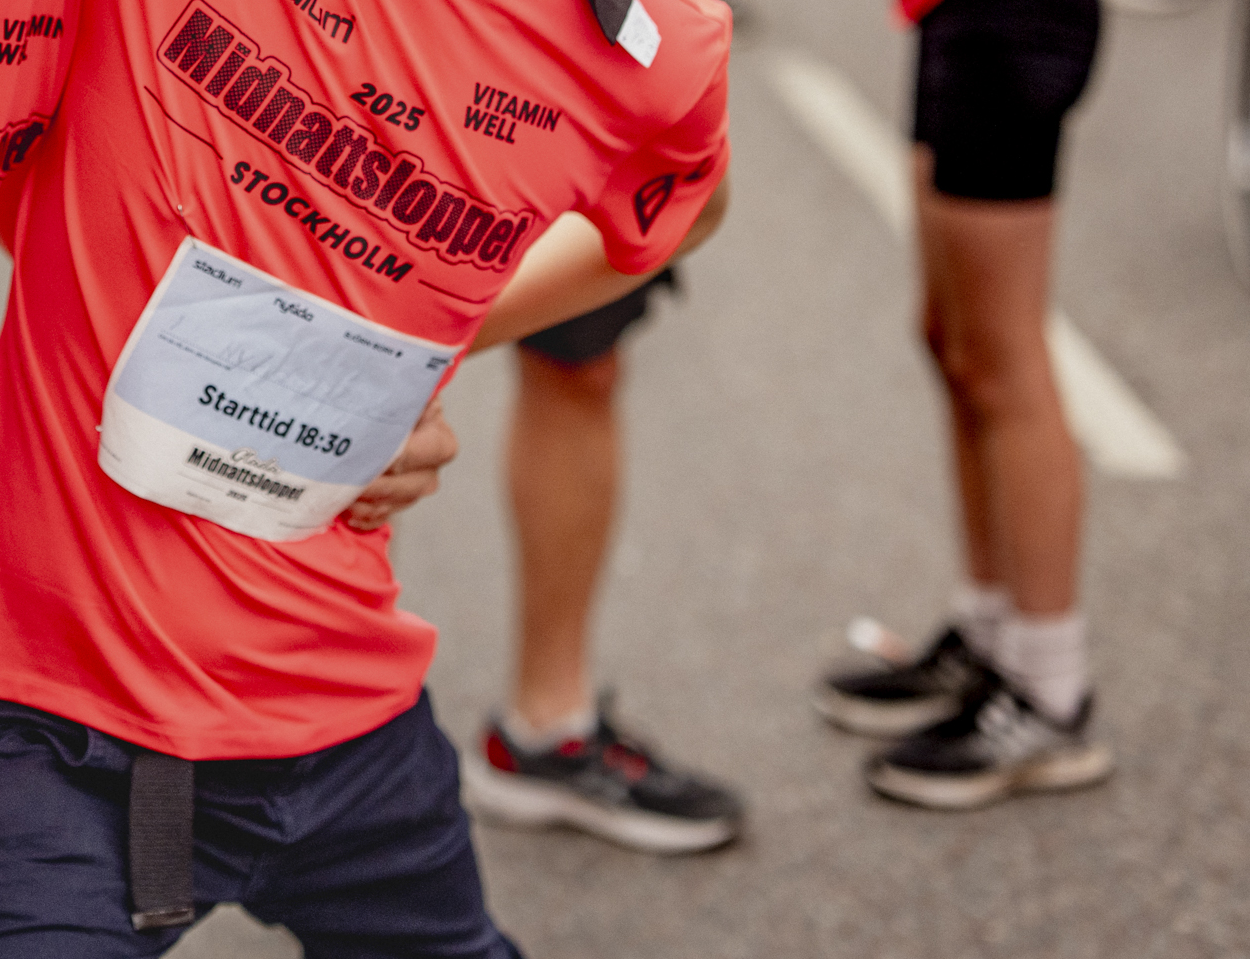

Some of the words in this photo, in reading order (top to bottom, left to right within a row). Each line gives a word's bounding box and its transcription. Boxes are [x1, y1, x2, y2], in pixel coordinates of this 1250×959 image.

[351, 82, 426, 132] 2025
[464, 105, 517, 145] WELL
[473, 82, 561, 133] VITAMIN
[163, 13, 535, 269] Midnattsloppet
[230, 161, 414, 283] STOCKHOLM
[192, 258, 243, 289] stadium
[199, 385, 296, 438] Starttid
[296, 424, 352, 458] 18:30
[187, 448, 306, 501] Midnattsloppet
